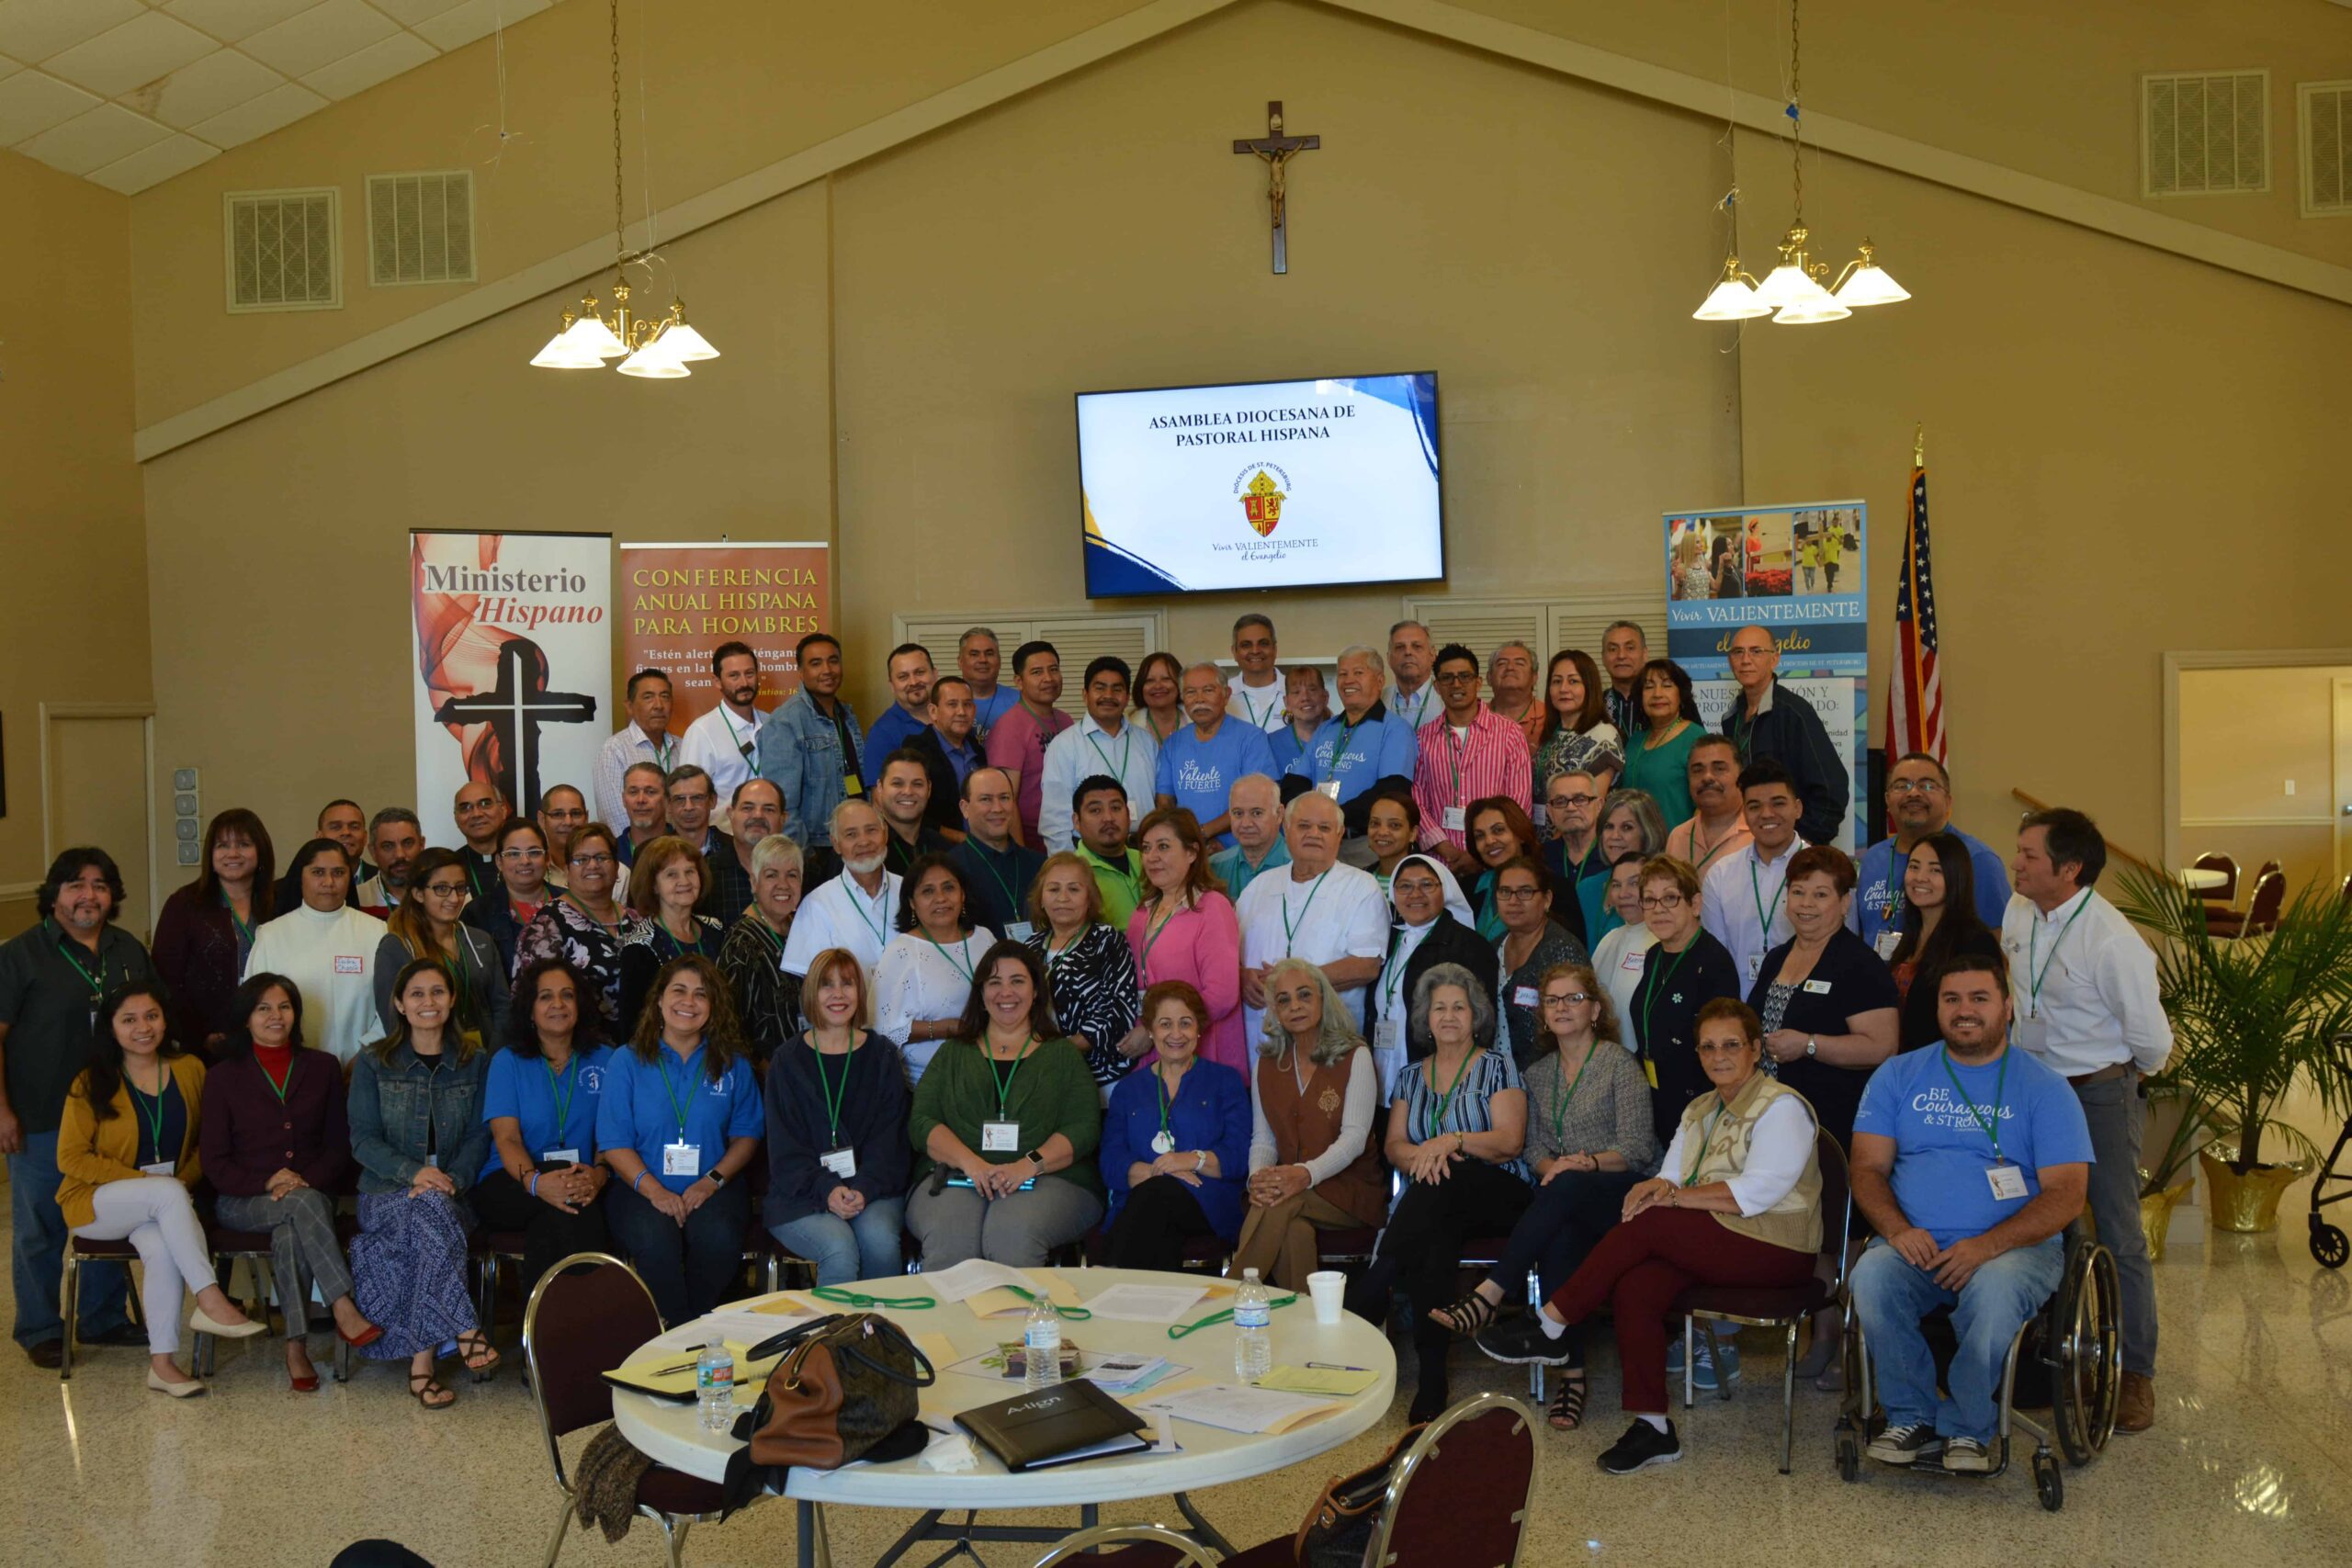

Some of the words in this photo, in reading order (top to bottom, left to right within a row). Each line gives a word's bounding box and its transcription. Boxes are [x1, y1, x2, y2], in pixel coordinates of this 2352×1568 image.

[1148, 412, 1232, 429] ASAMBLEA
[1237, 406, 1330, 424] DIOCESANA
[1334, 405, 1355, 418] DE
[1176, 430, 1257, 446] PASTORAL
[1261, 426, 1330, 441] HISPANA
[1266, 462, 1292, 491] PETERSBURG
[1213, 543, 1232, 551] Vivir
[1235, 538, 1318, 551] VALIENTEMENTE
[1241, 551, 1249, 561] el
[1250, 549, 1286, 562] Evangelio
[425, 565, 586, 593] Ministerio
[633, 568, 819, 587] CONFERENCIA
[633, 593, 712, 611] ANUAL
[719, 592, 818, 610] HISPANA
[478, 597, 603, 630] Hispano
[1672, 608, 1702, 622] Vivir
[1706, 601, 1860, 623] VALIENTEMENTE
[634, 617, 693, 635] PARA
[702, 615, 819, 635] HOMBRES
[1716, 631, 1732, 652] el
[643, 649, 682, 660] "Estén
[685, 649, 714, 660] alert
[677, 665, 691, 673] en
[695, 663, 707, 673] la
[759, 661, 798, 671] hombr
[684, 679, 712, 688] sean
[1700, 688, 1743, 699] NUEST
[1821, 686, 1828, 697] Y
[1179, 766, 1221, 781] Valiente
[1178, 781, 1182, 790] Y
[1185, 779, 1221, 790] FUERTE
[1873, 880, 1887, 890] BE
[1928, 1088, 1950, 1100] BE
[1924, 1113, 1935, 1124] &
[1936, 1114, 1992, 1128] STRONG
